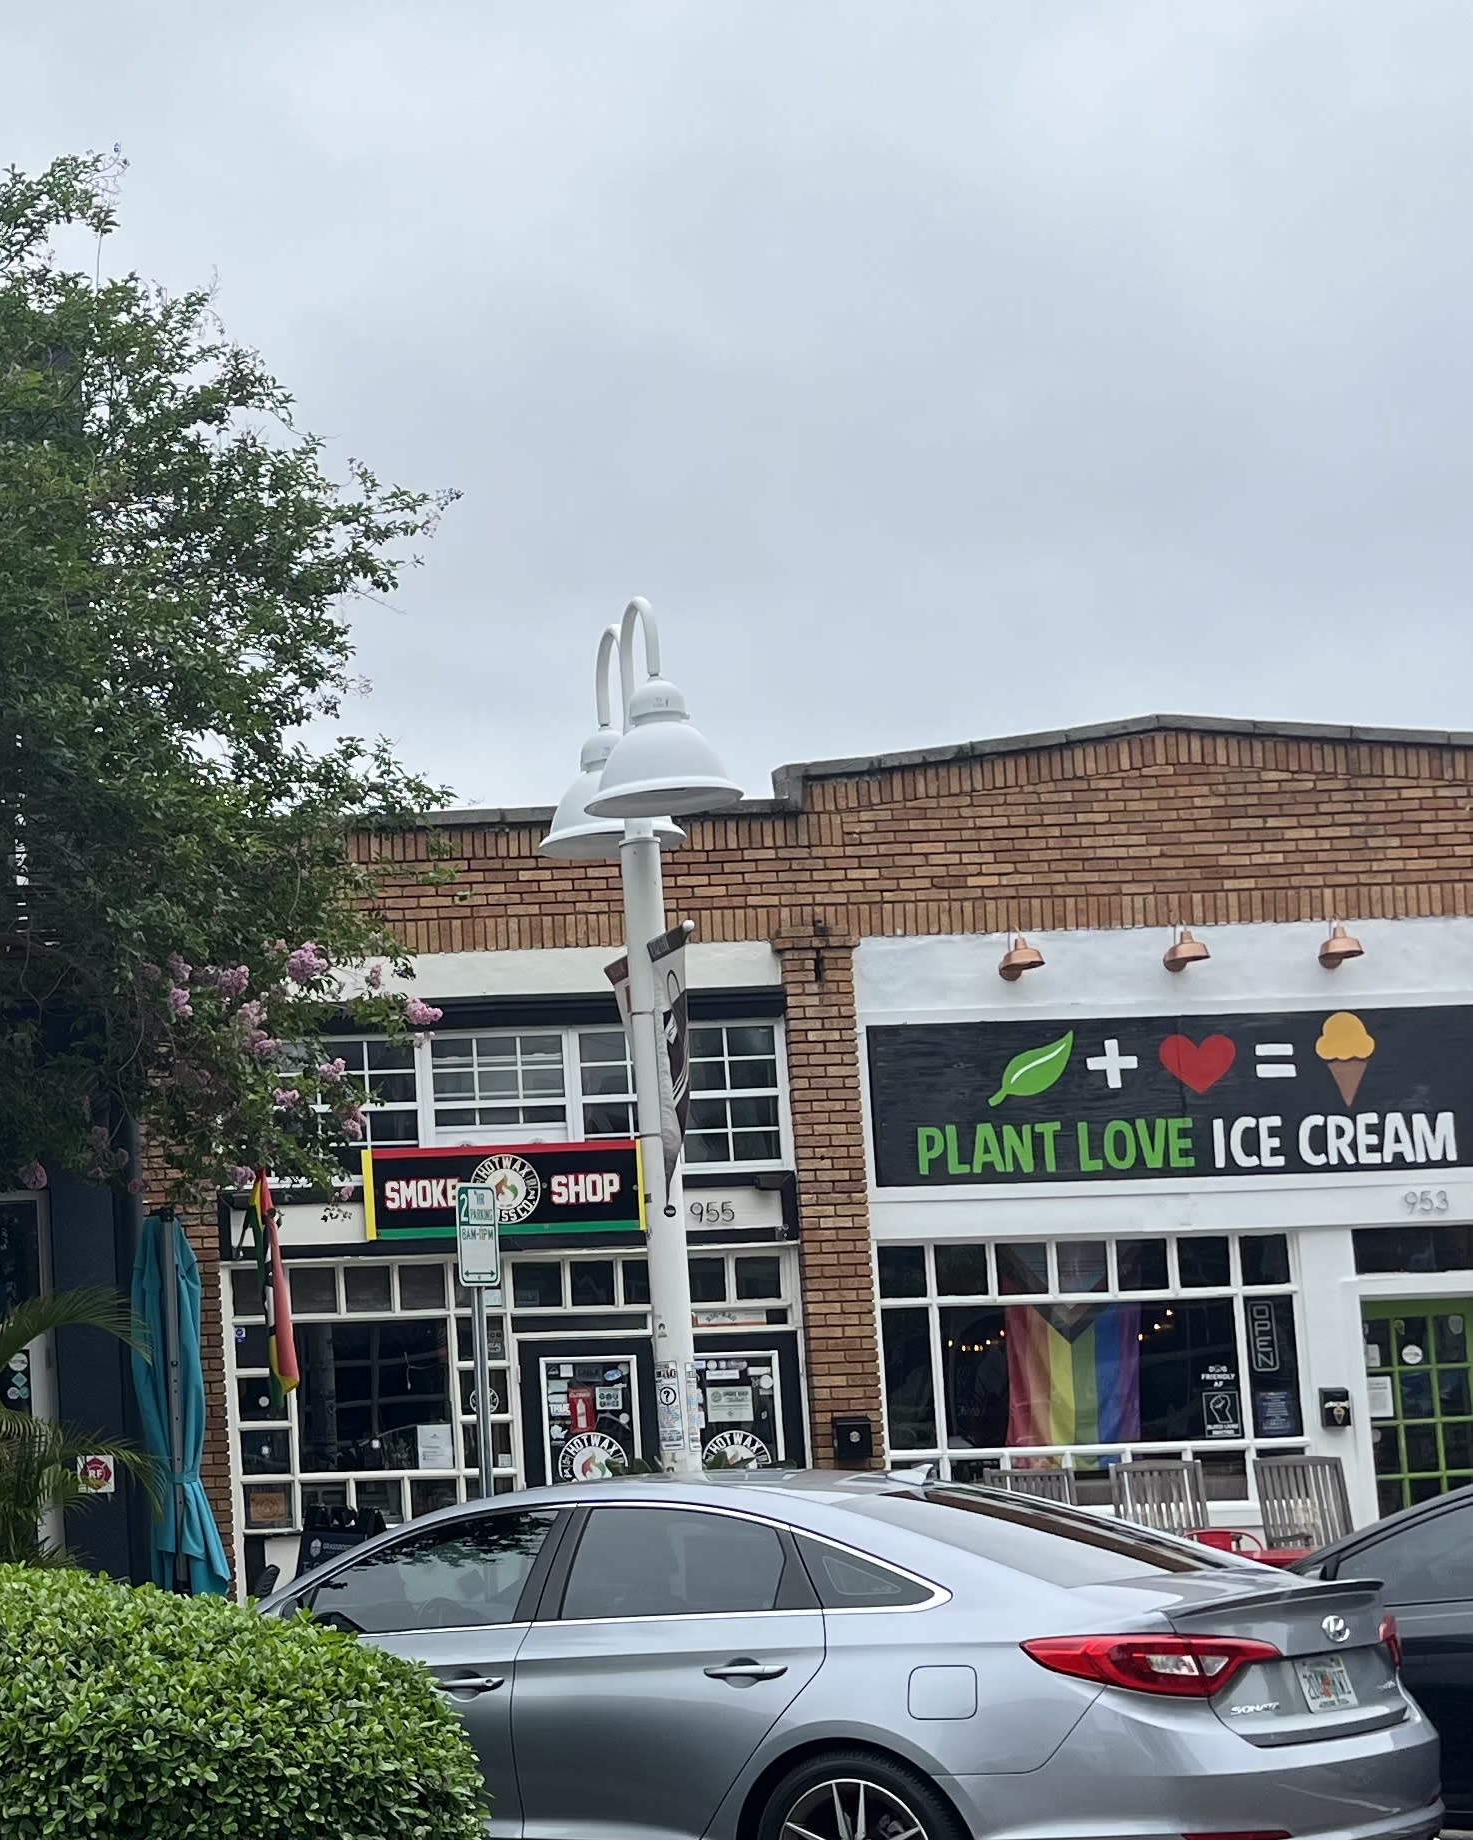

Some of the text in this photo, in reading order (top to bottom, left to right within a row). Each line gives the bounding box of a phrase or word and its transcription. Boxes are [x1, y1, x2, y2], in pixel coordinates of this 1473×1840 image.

[917, 1111, 1458, 1175] PLANT LOVE ICE CREAM
[384, 1173, 620, 1211] SMOKE SHOP
[1403, 1190, 1450, 1214] 953
[459, 1193, 469, 1222] 2
[470, 1208, 493, 1221] PARKING
[690, 1201, 735, 1224] 955
[1252, 1305, 1275, 1368] OPEN
[88, 1469, 103, 1479] RF
